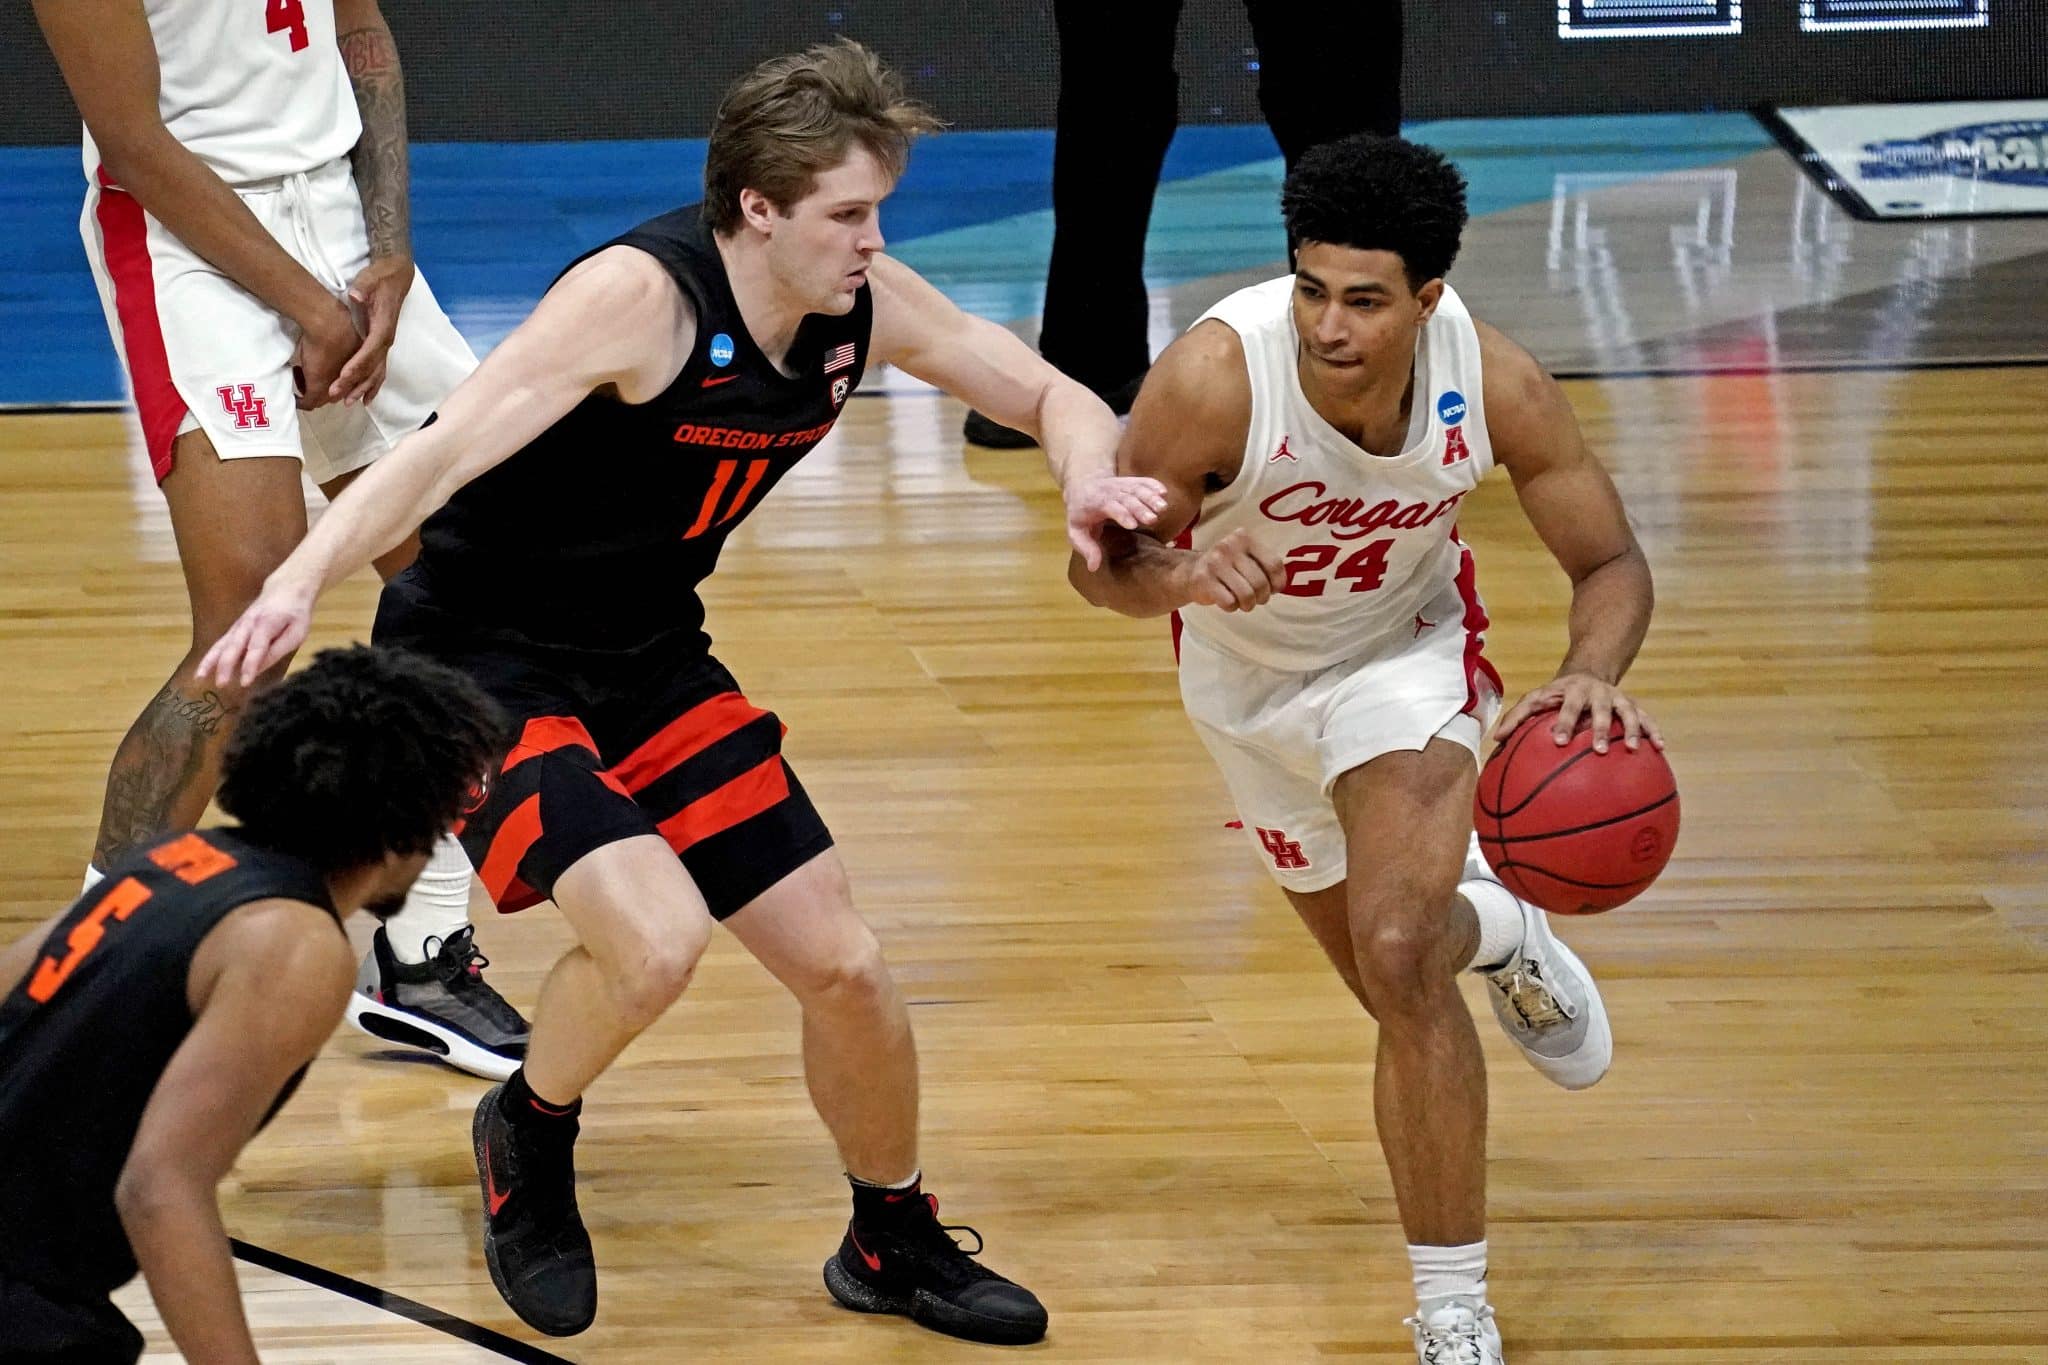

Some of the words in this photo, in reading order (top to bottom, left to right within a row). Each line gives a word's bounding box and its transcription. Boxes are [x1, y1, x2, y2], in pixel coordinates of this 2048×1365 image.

[265, 0, 310, 53] 4
[216, 383, 270, 429] UH
[1442, 403, 1466, 418] NCAA
[674, 424, 775, 449] OREGON
[681, 459, 770, 540] 11
[1279, 539, 1396, 597] 24
[1255, 827, 1310, 869] UH
[27, 876, 153, 1005] 5
